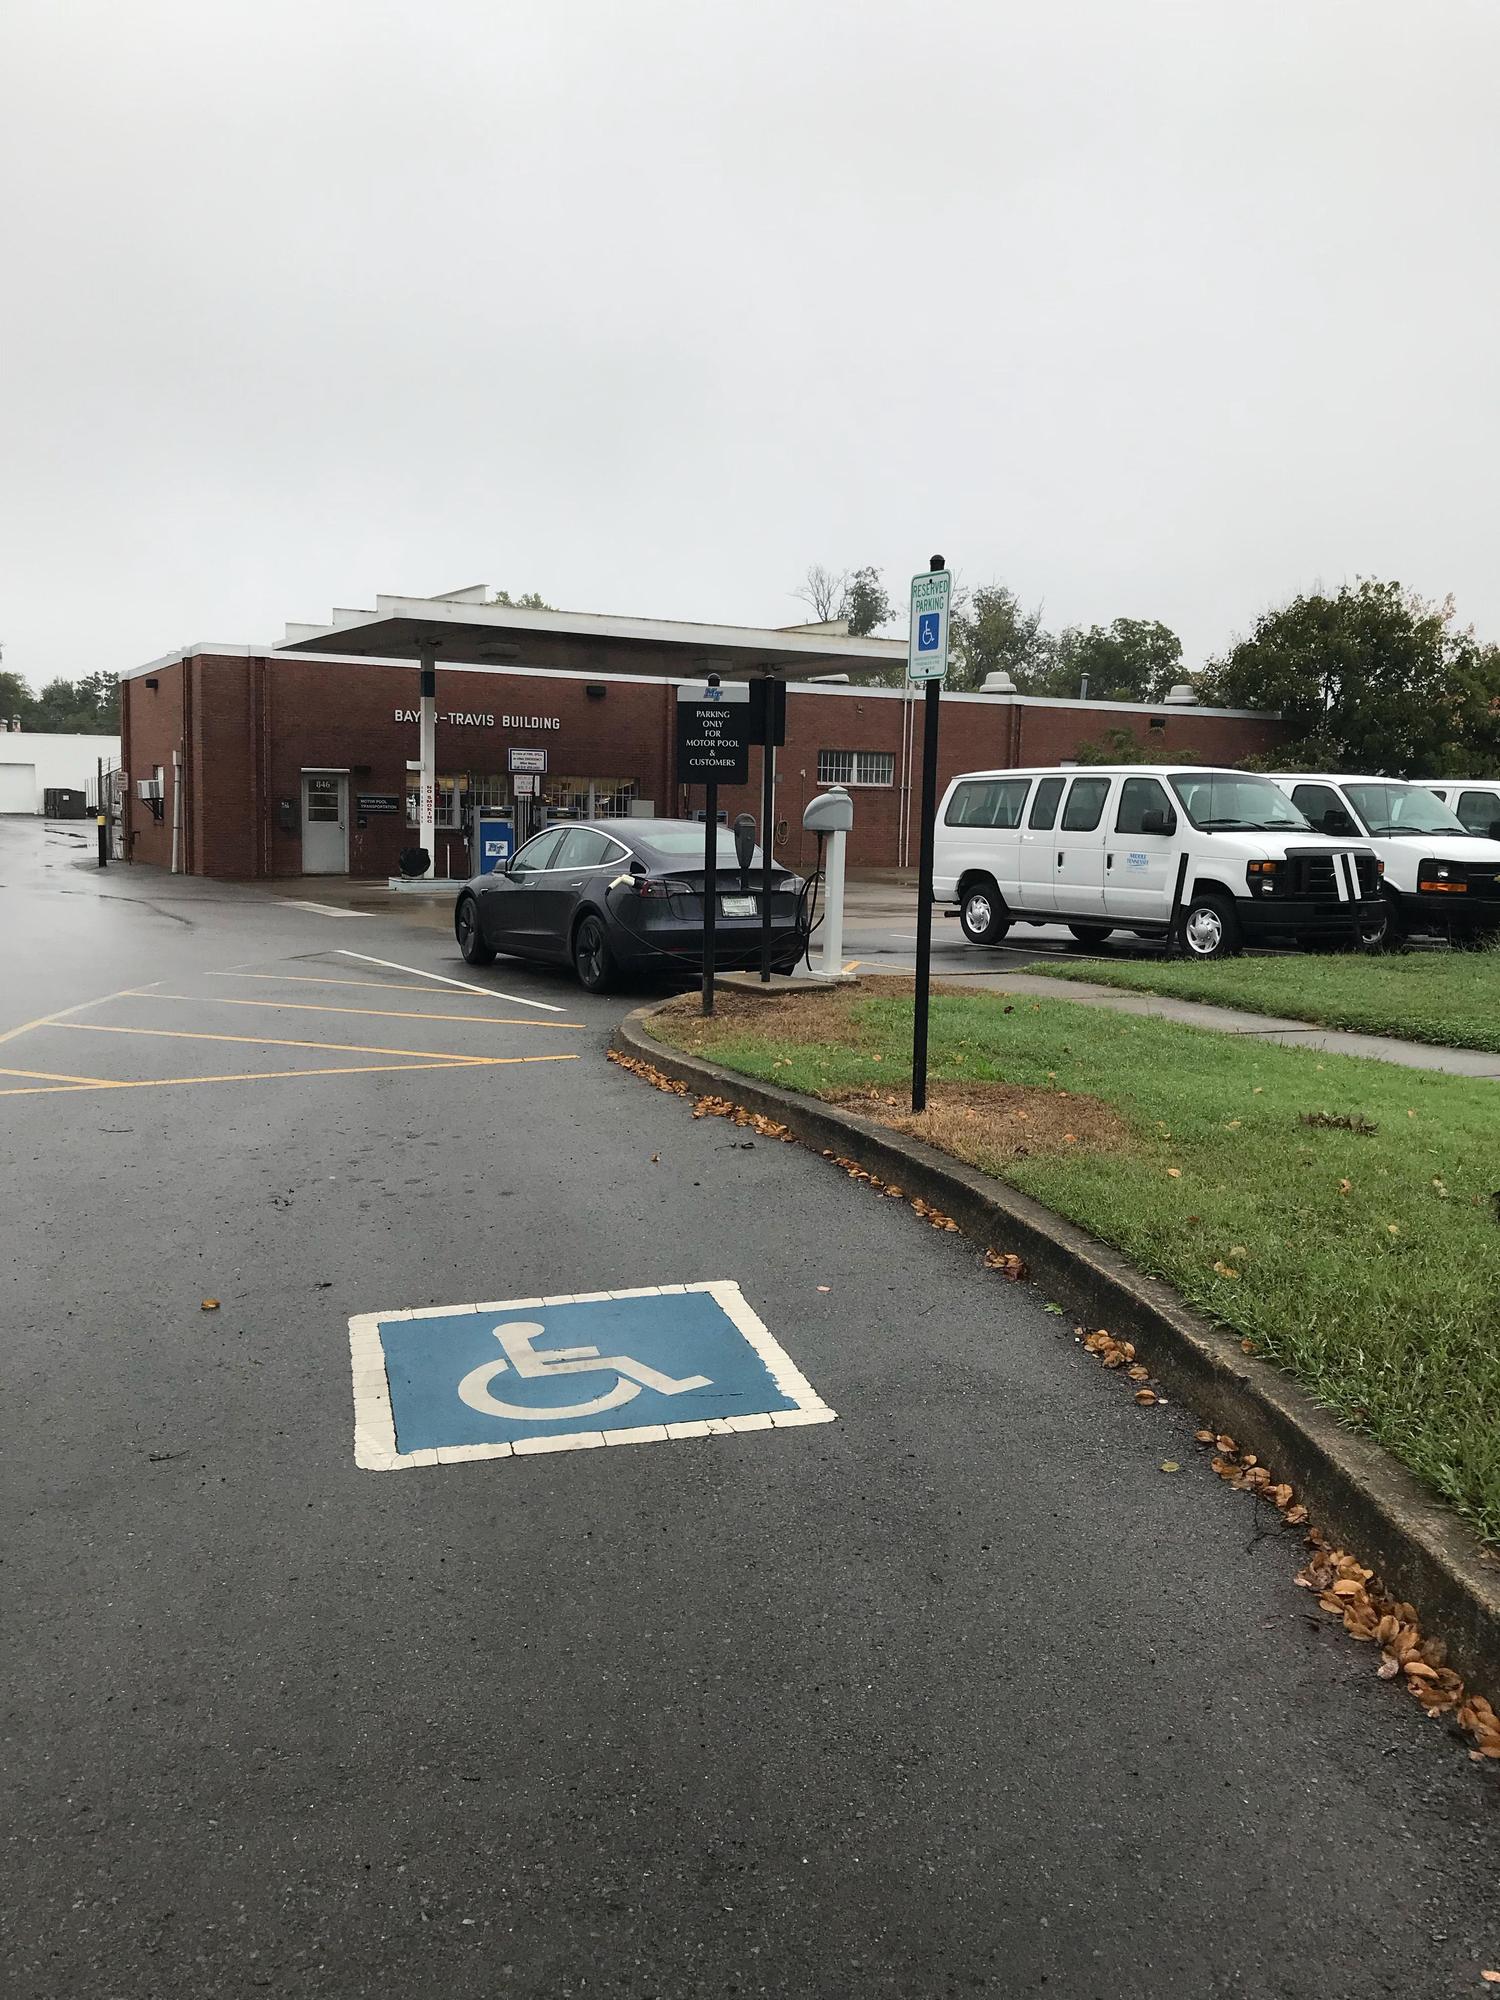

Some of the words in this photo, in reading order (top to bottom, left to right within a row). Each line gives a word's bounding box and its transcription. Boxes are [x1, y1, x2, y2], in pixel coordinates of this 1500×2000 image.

[912, 580, 948, 598] RESERVED
[916, 597, 944, 613] PARKING
[696, 710, 730, 718] PARKING
[394, 709, 495, 726] BAYR-TRAVIS
[502, 715, 561, 730] BUILDING
[702, 720, 724, 728] ONLY
[686, 739, 716, 747] MOTOR
[717, 739, 740, 747] POOL
[709, 749, 716, 757] &
[689, 758, 736, 767] CUSTOMERS
[315, 781, 331, 789] 846
[426, 785, 433, 794] NO
